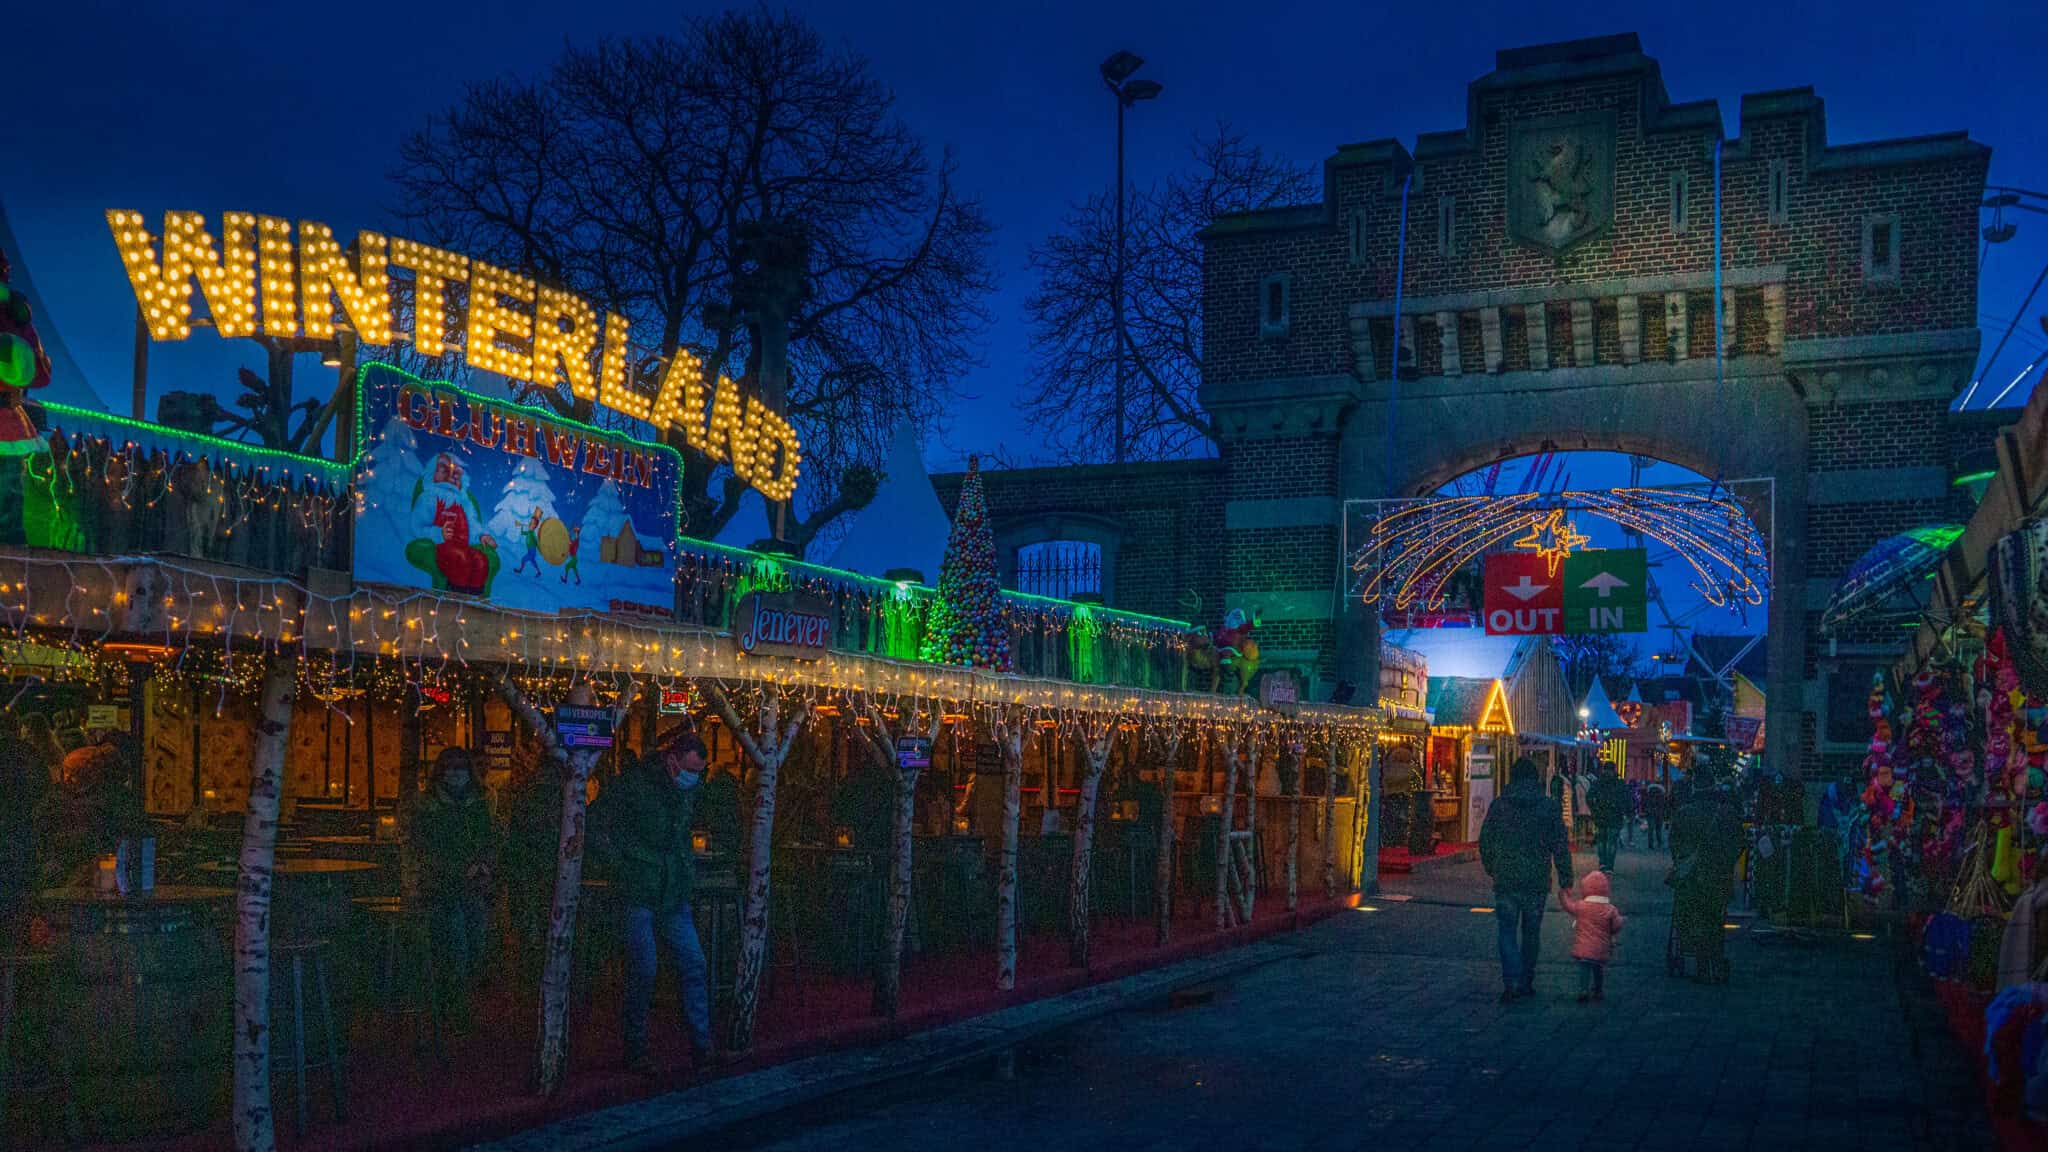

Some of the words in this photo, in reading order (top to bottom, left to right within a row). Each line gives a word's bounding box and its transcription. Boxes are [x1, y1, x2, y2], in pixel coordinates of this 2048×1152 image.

[105, 208, 801, 502] WINTERLAND
[742, 591, 831, 652] Jenever
[1489, 608, 1560, 632] OUT
[1589, 606, 1624, 629] IN
